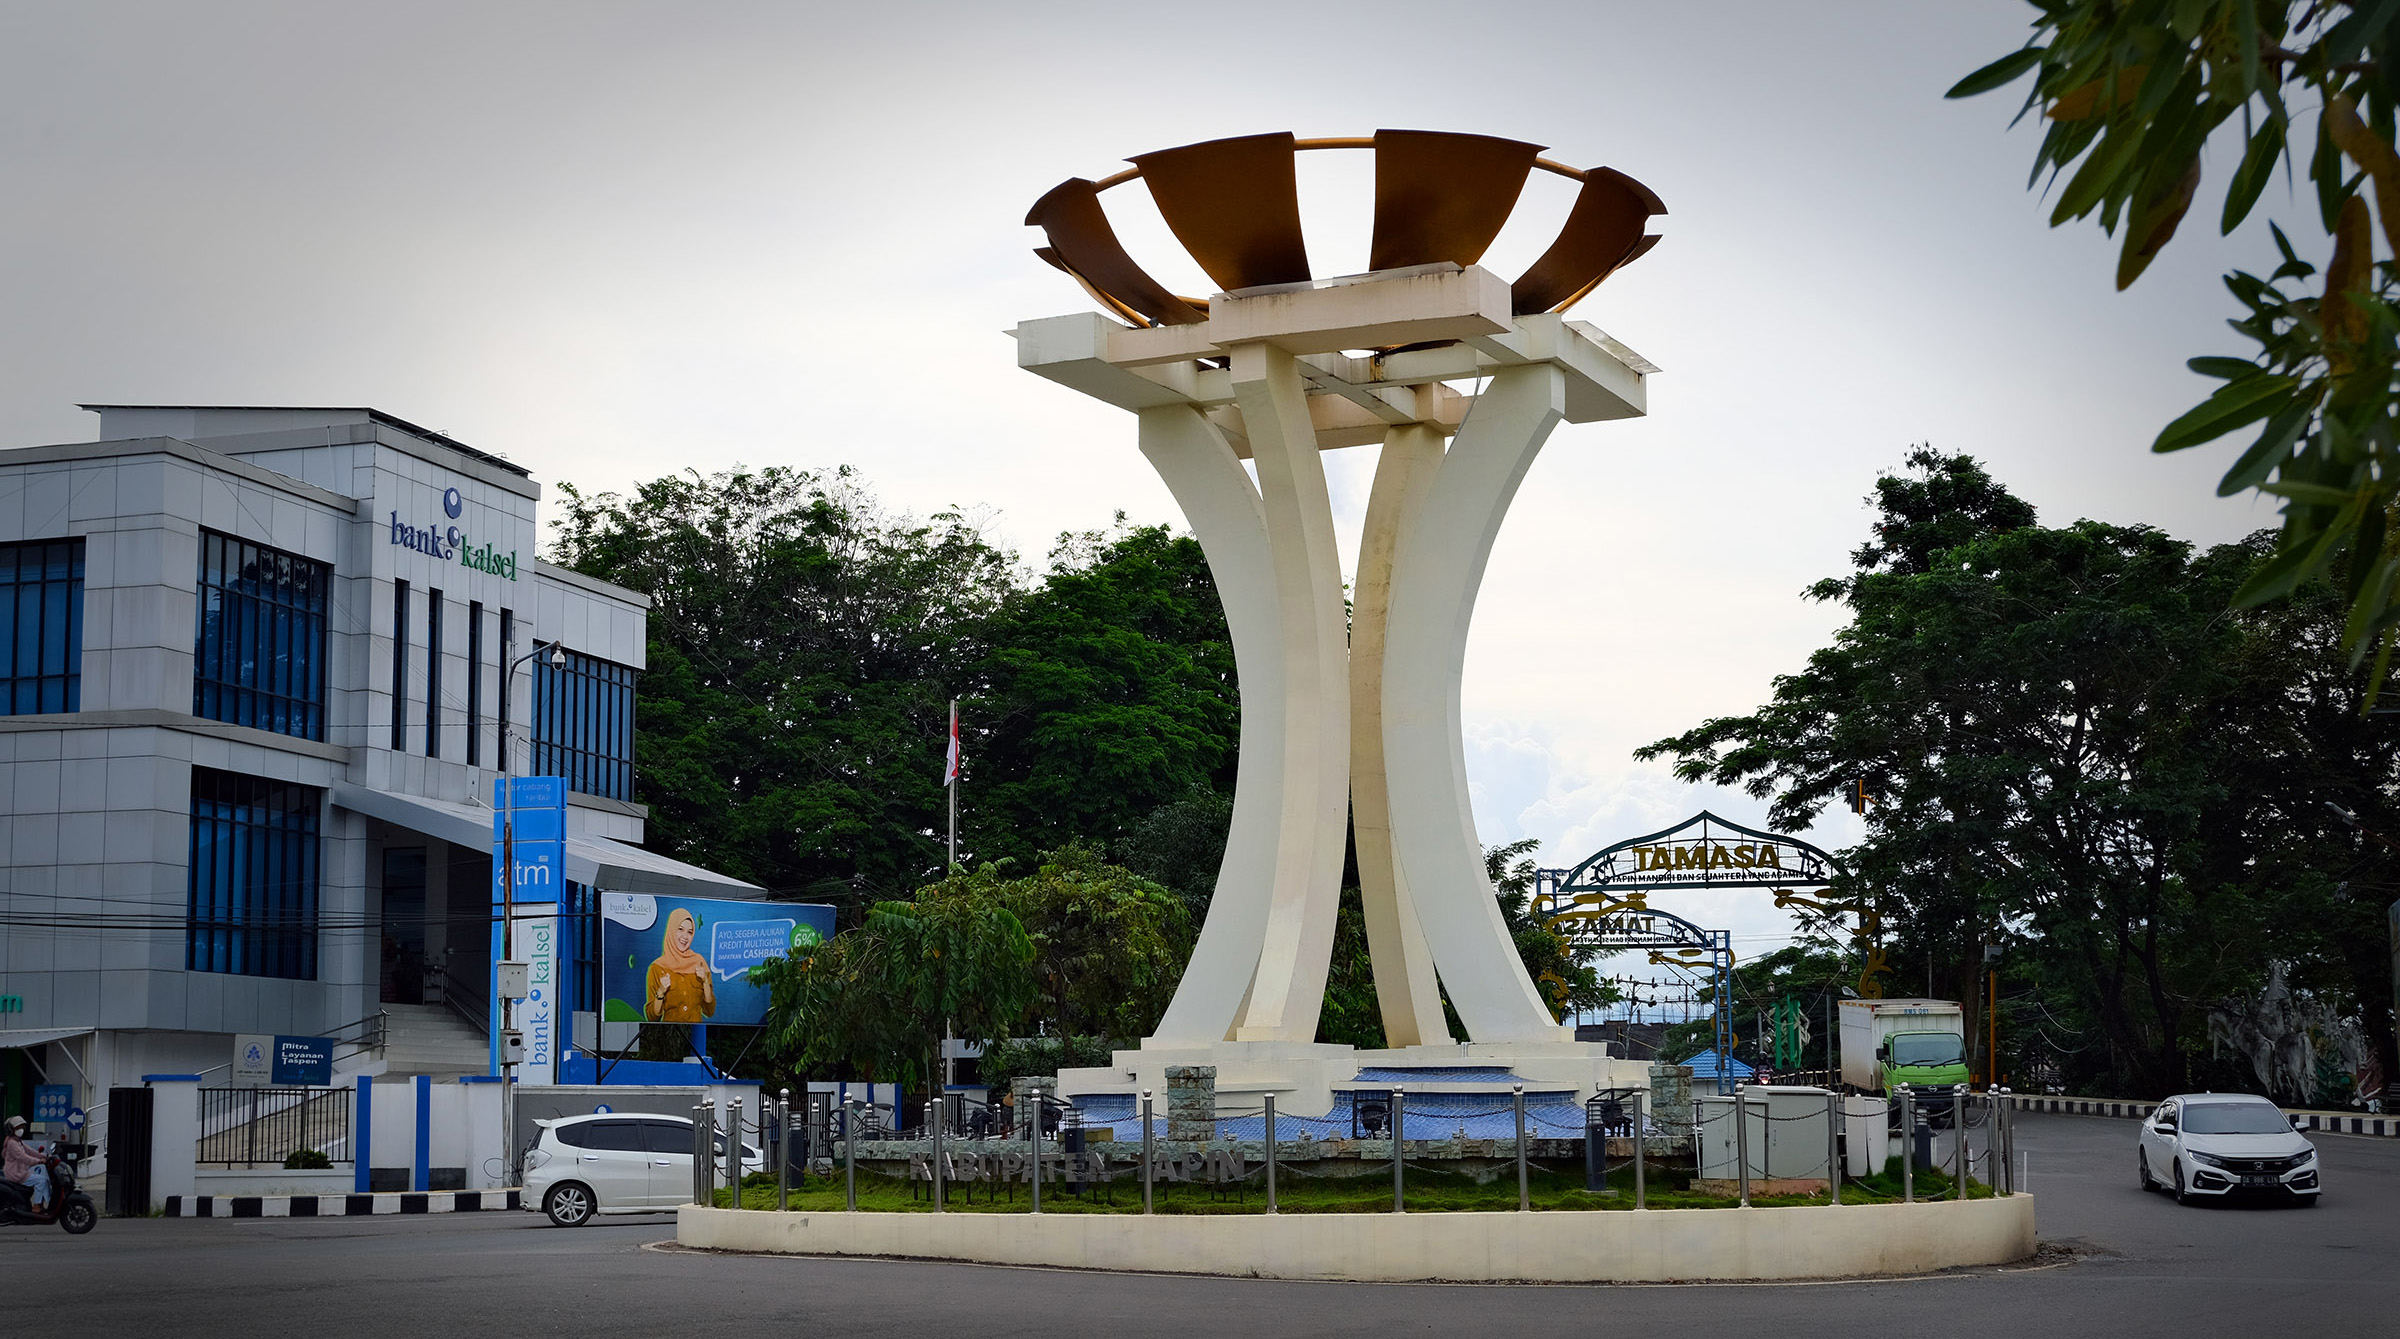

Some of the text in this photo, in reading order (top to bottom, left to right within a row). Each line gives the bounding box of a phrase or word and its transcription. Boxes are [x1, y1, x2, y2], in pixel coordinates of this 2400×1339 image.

[391, 510, 517, 581] bank kalsel
[1632, 845, 1781, 871] TAMASA
[1612, 874, 1636, 882] TAPIN
[1638, 873, 1675, 882] MANDIRI
[1677, 873, 1695, 881] DAN
[735, 929, 759, 939] SEGERA
[760, 927, 785, 937] AJUKAN
[719, 938, 784, 950] KREDIT MULTIGUNA
[530, 923, 550, 985] kalsel
[743, 948, 785, 959] CASHBACK
[529, 1011, 549, 1067] bank
[282, 1043, 309, 1051] Mitra
[281, 1051, 324, 1059] Layanan
